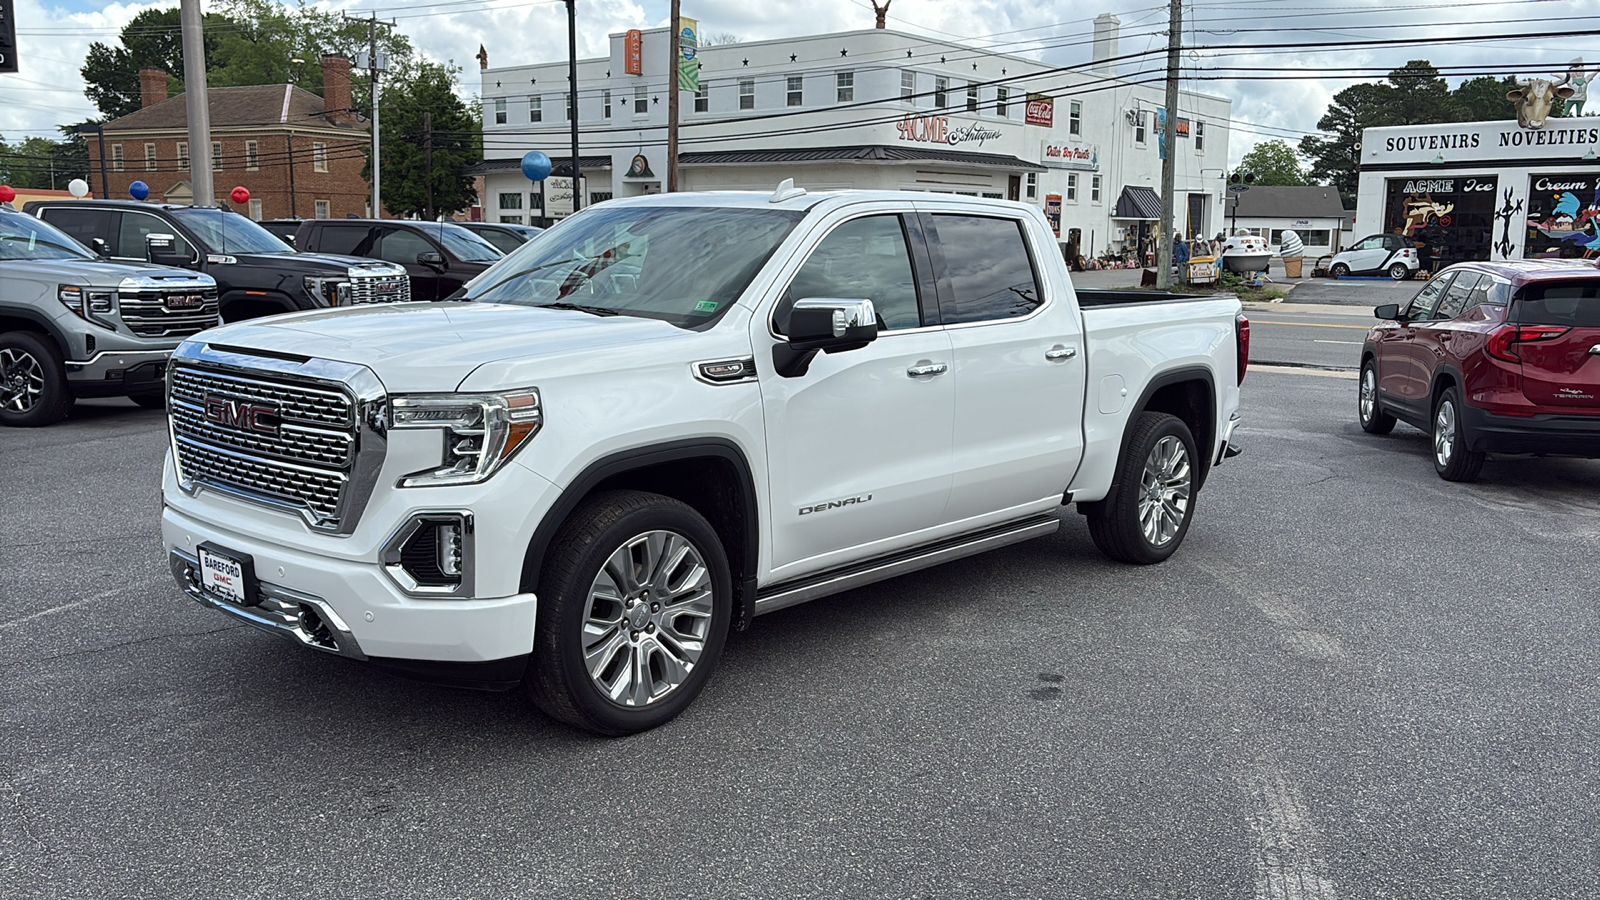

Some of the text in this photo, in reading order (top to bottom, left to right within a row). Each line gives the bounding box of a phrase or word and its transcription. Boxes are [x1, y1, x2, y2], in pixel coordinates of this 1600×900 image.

[631, 32, 640, 72] ACME
[896, 114, 1003, 147] ACME Antiques
[1386, 129, 1599, 151] SOUVENIRS NOVELTIES
[1046, 145, 1090, 161] Dutch Boy Paints
[1403, 179, 1495, 193] ACME Ice
[1535, 177, 1587, 191] Cream
[168, 295, 202, 307] GMC
[204, 397, 279, 435] GMC
[798, 493, 873, 516] DENALI
[204, 556, 240, 578] BAREFORD
[213, 572, 233, 586] GMC
